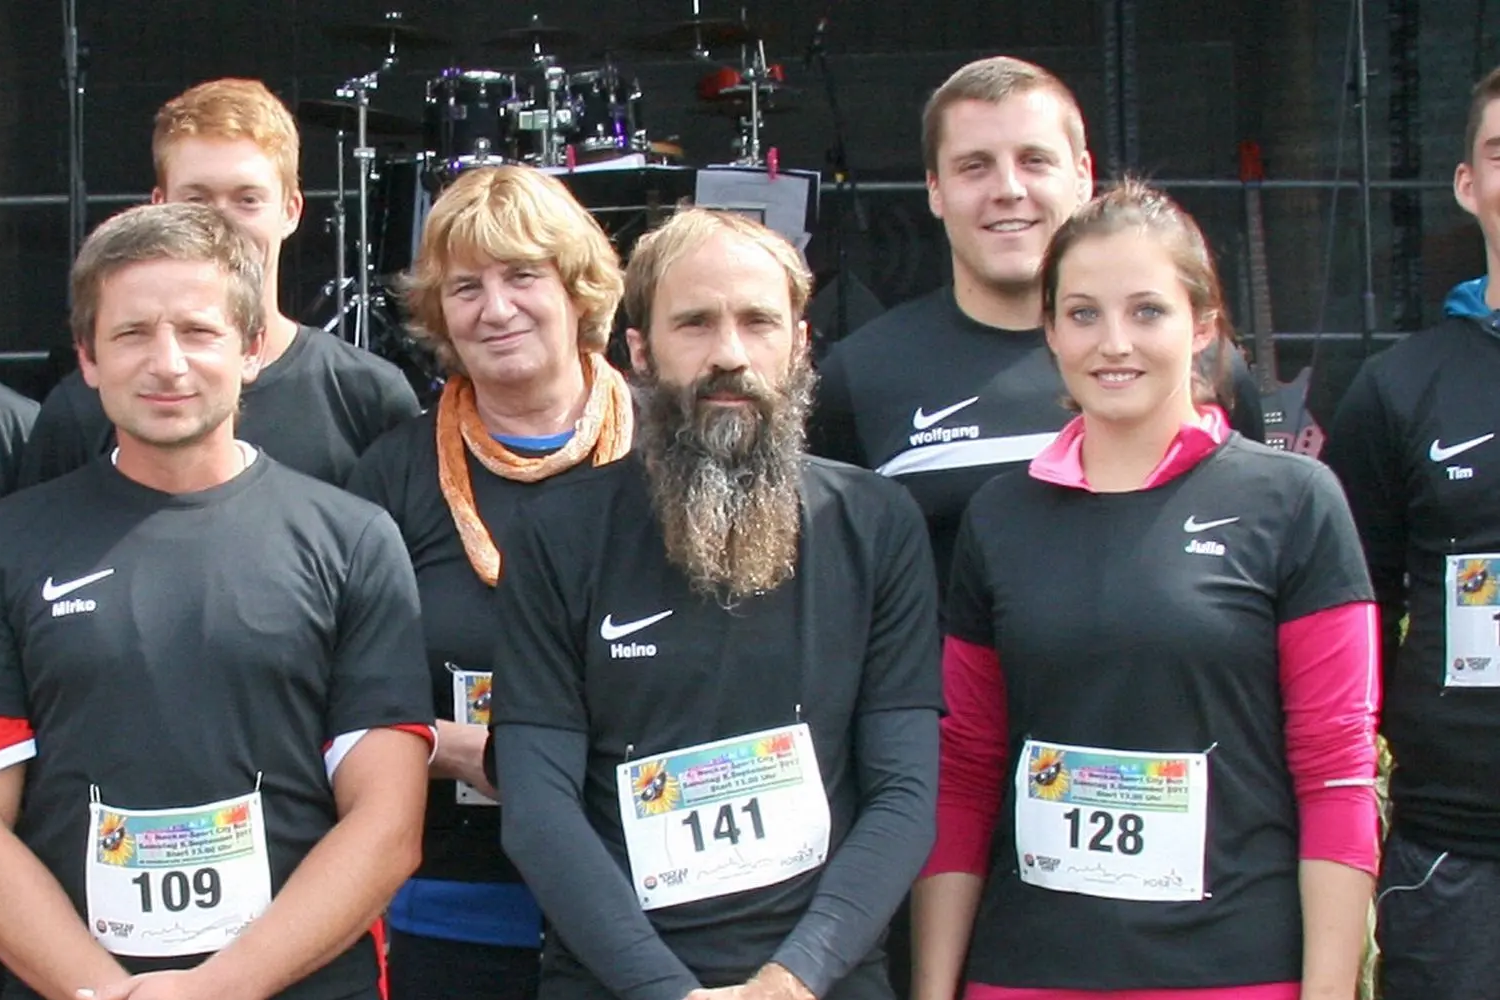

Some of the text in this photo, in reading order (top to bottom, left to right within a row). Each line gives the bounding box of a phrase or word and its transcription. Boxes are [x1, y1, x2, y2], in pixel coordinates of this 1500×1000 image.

[909, 425, 980, 446] Wolfgang
[1446, 466, 1474, 480] Tim
[51, 599, 97, 617] Mirko
[610, 642, 657, 659] Heino
[682, 797, 765, 853] 141
[1063, 807, 1144, 856] 128
[132, 867, 222, 913] 109
